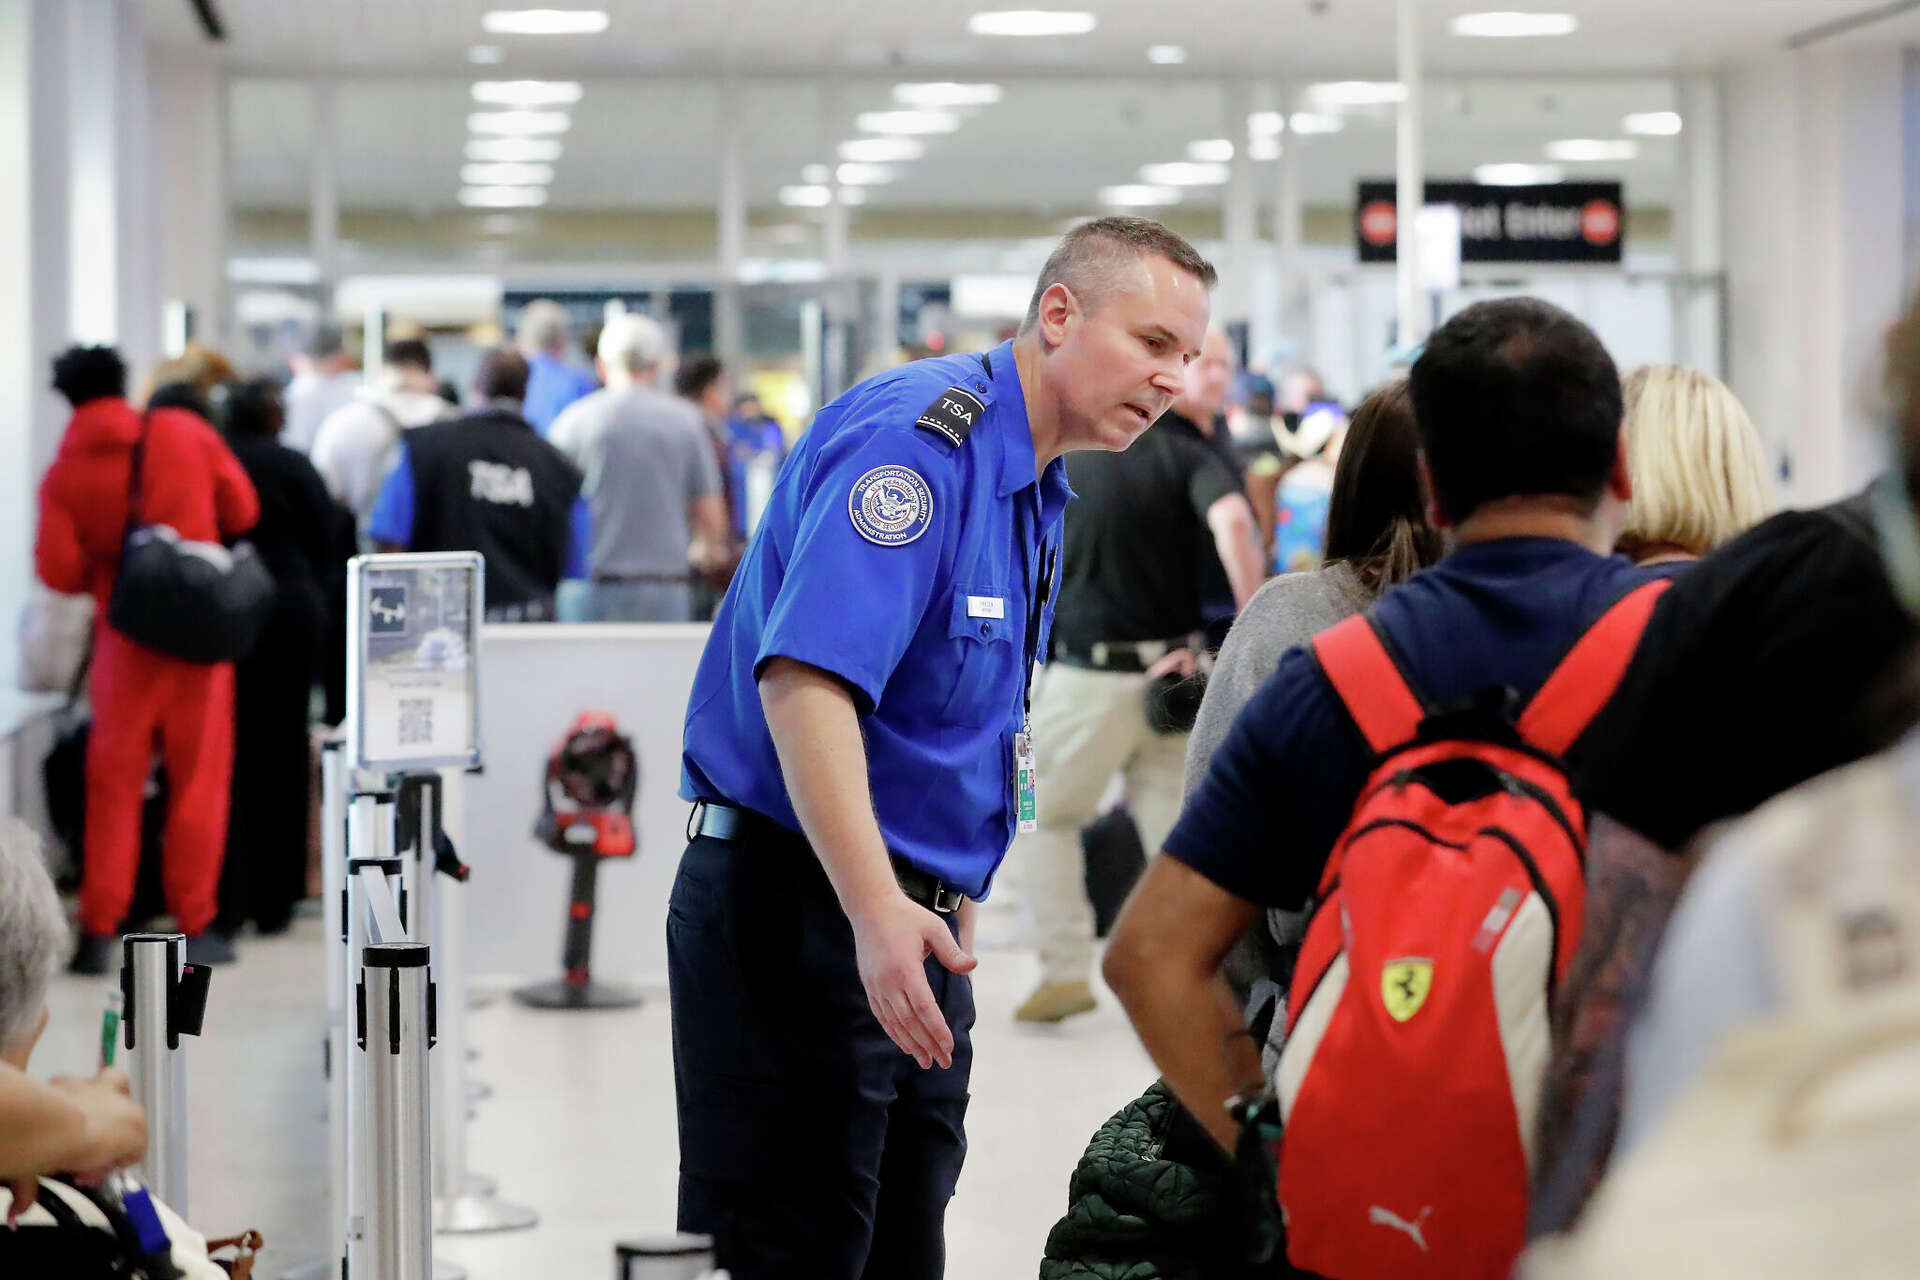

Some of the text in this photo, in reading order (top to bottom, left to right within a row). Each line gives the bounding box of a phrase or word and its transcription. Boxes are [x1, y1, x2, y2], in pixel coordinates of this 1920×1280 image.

[942, 397, 972, 426] TSA
[468, 460, 535, 508] TSA
[858, 470, 929, 524] TRANSPORTATION SECURITY
[852, 509, 908, 540] ADMINISTRATION
